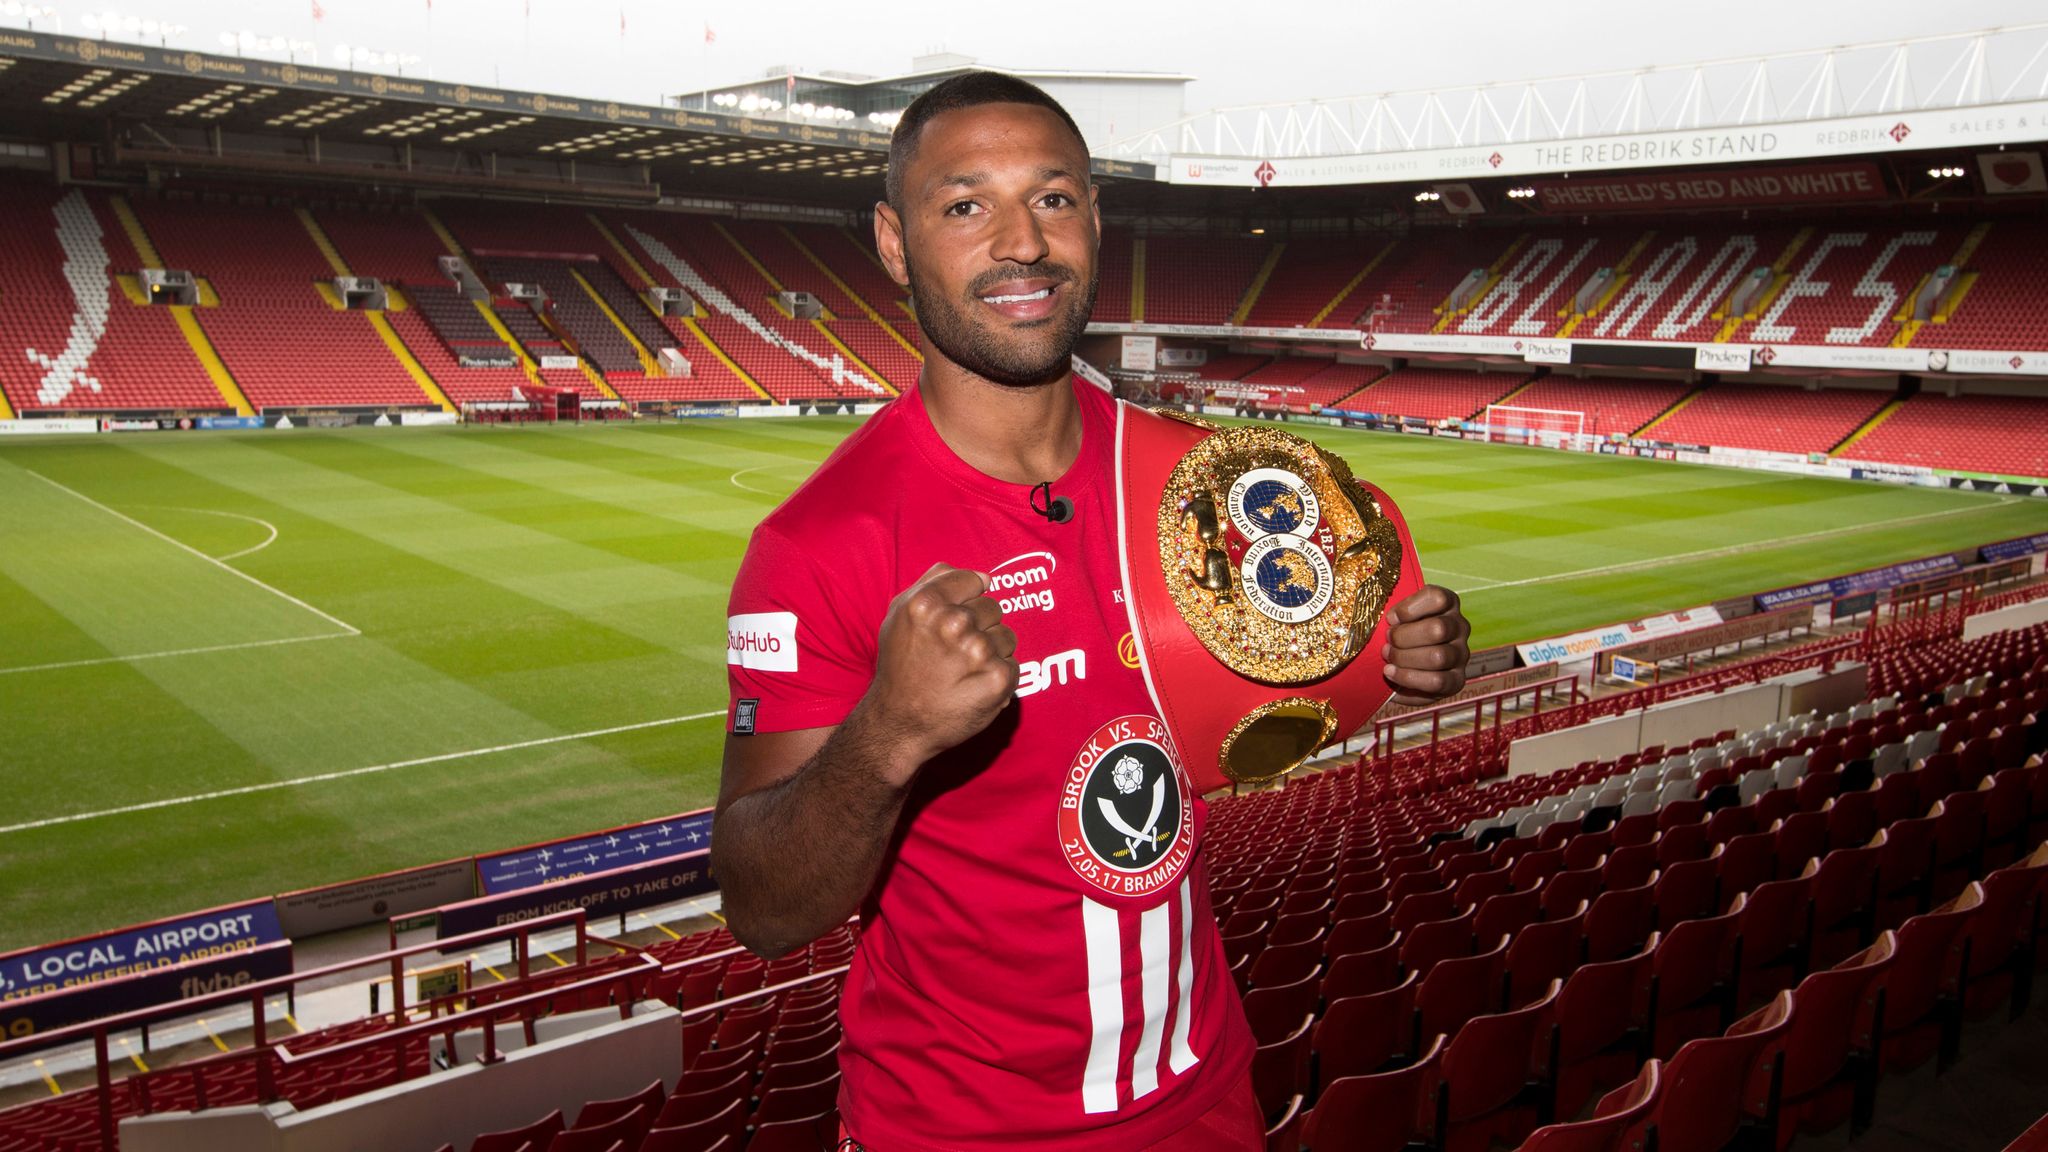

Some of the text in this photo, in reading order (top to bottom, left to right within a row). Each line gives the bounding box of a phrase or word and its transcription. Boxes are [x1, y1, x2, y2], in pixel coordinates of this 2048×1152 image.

[1816, 127, 1887, 146] REDBRIK
[1949, 118, 2005, 135] SALES
[1439, 155, 1487, 169] REDBRIK
[1536, 132, 1777, 166] THE REDBRIK STAND
[1544, 170, 1872, 205] SHEFFIELD'S RED AND WHITE
[1528, 343, 1569, 357] Pinders
[1699, 349, 1748, 363] Pinders
[1228, 482, 1255, 538] Champion
[1297, 483, 1317, 528] World
[1318, 526, 1335, 555] IBF
[1000, 589, 1055, 614] oxing
[1242, 574, 1294, 621] Federation
[1529, 631, 1627, 662] alpharooms.com
[1063, 721, 1183, 809] BROOK VS. SPENCE
[1064, 799, 1192, 893] 27.05.17 BRAMALL LANE
[497, 906, 539, 926] FROM
[543, 898, 576, 915] KICK
[580, 890, 608, 908] OFF
[611, 887, 631, 901] TO
[634, 878, 669, 896] TAKE
[671, 871, 699, 888] OFF
[23, 945, 125, 981] LOCAL
[134, 914, 253, 957] AIRPORT
[3, 983, 58, 1001] STER
